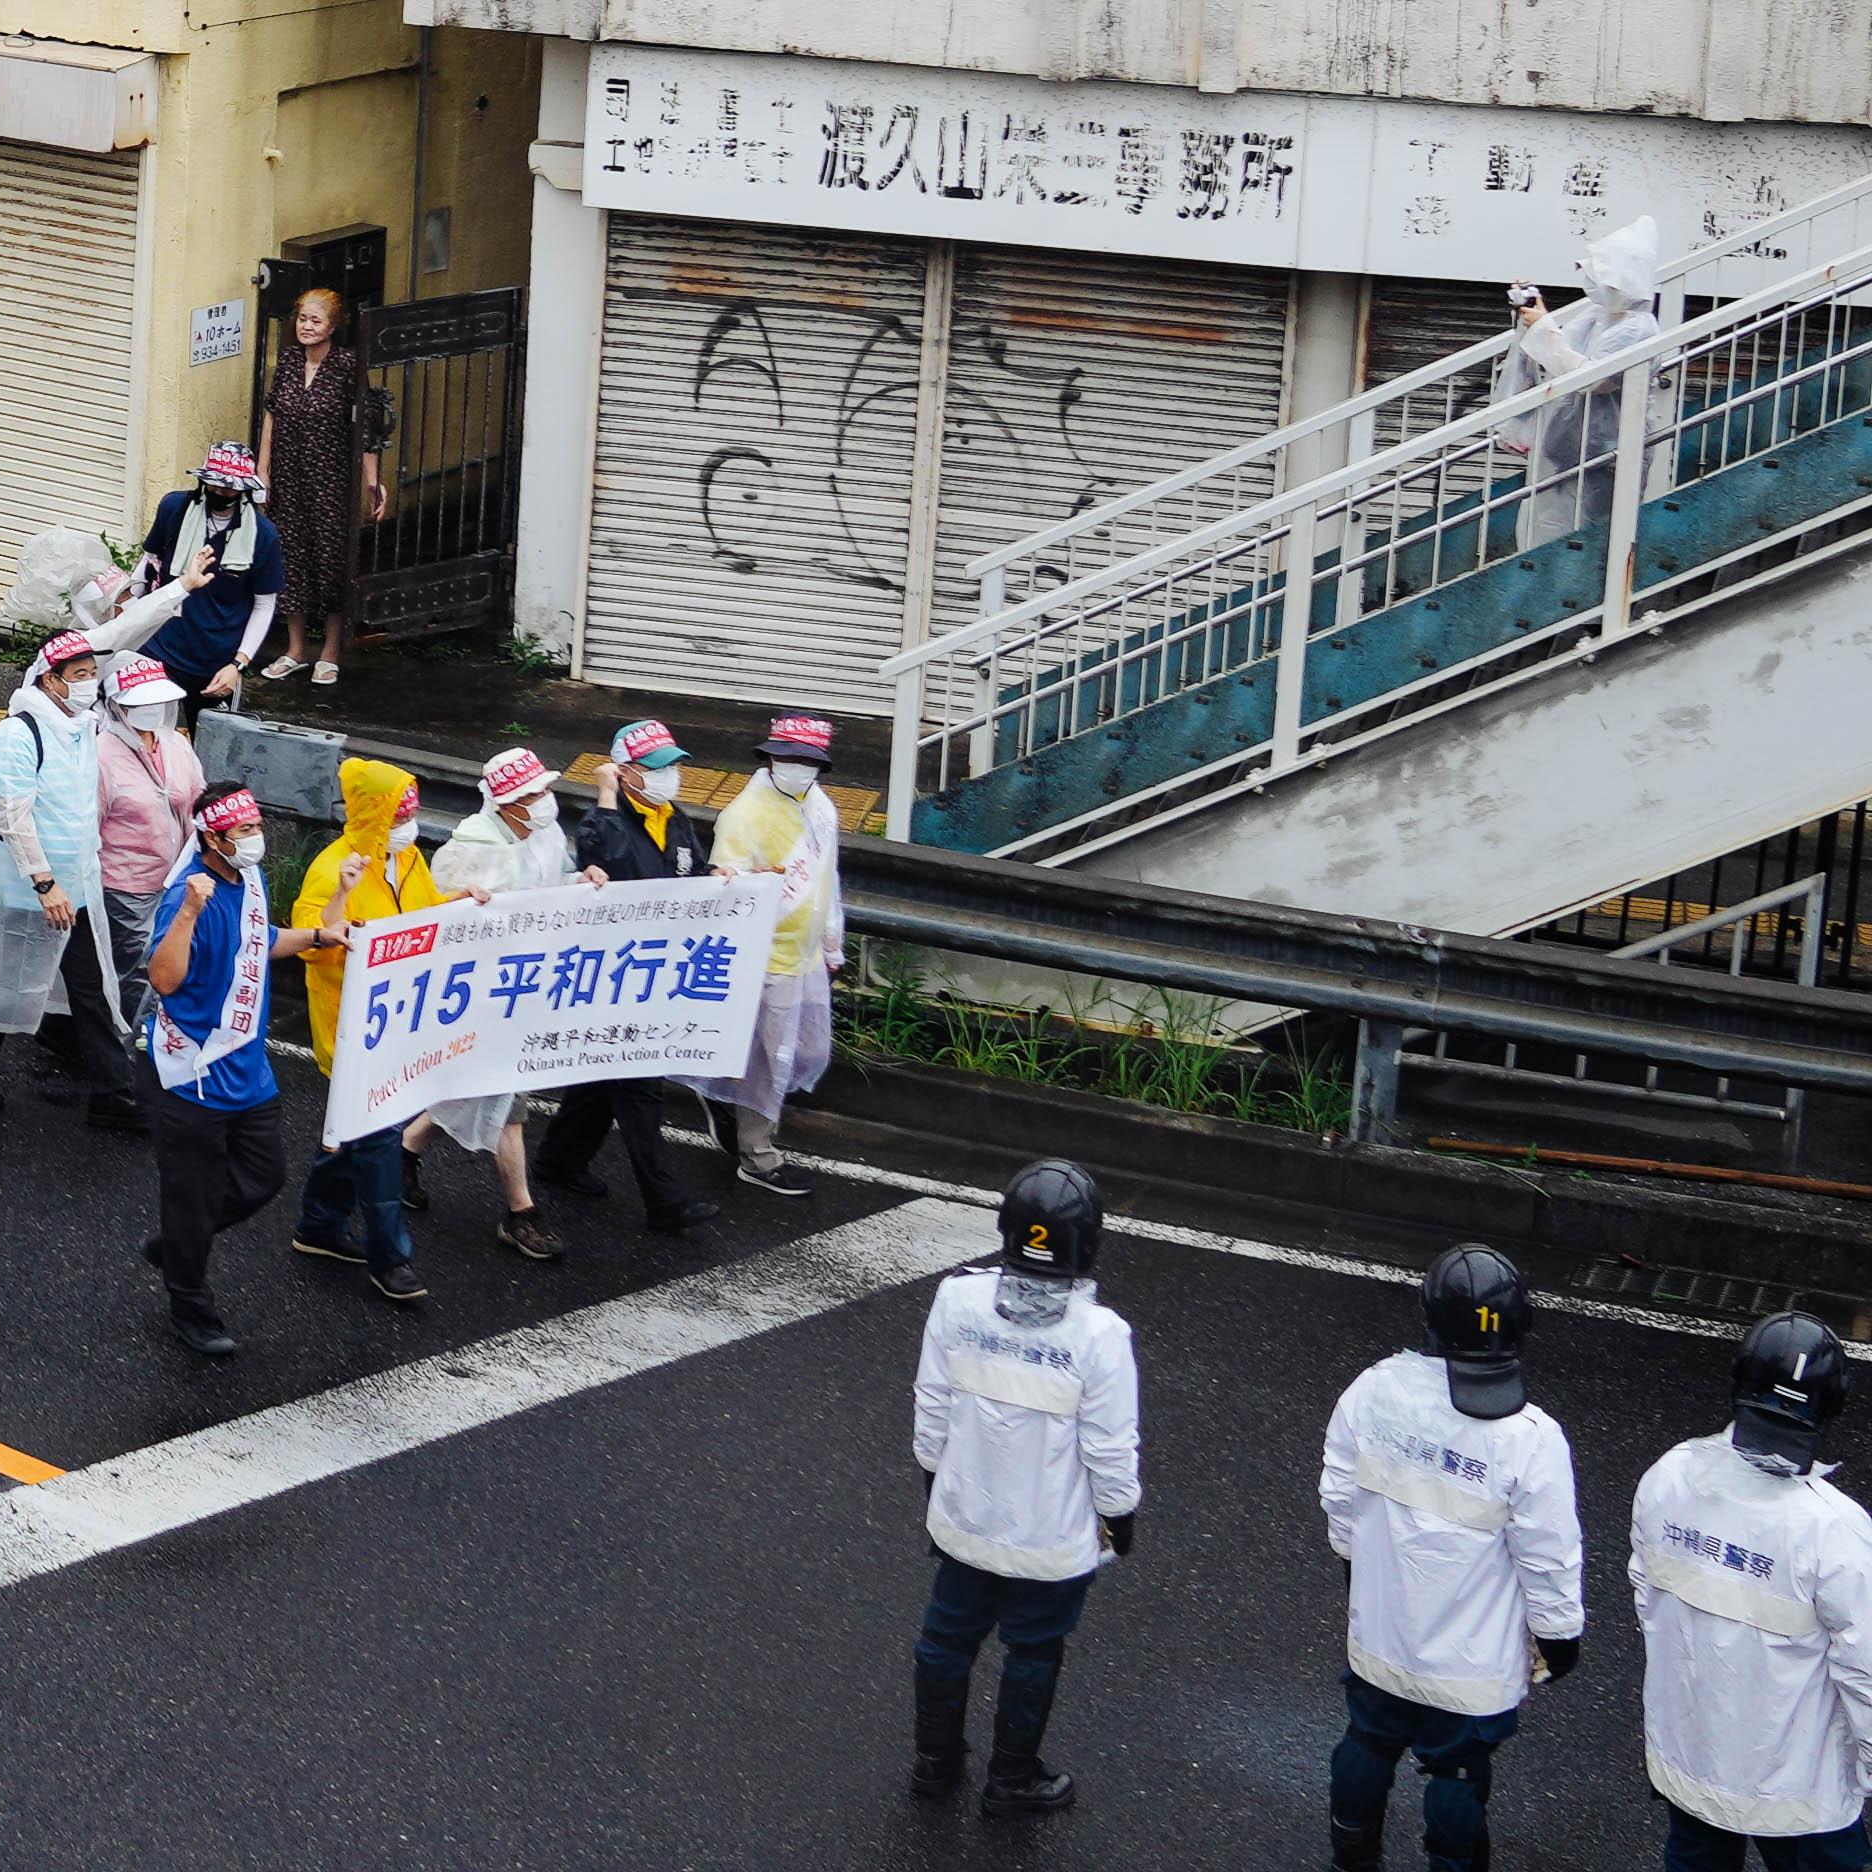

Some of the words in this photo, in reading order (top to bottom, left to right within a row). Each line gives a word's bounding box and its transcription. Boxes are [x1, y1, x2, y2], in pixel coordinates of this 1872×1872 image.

[489, 933, 739, 1019] 平和行進
[517, 1055, 574, 1074] Okinawa
[577, 1051, 616, 1069] Peace
[619, 1047, 659, 1064] Action
[664, 1045, 718, 1062] Center
[367, 1073, 400, 1114] Peace
[400, 1047, 445, 1085] Action
[1028, 1224, 1049, 1251] 2
[1474, 1305, 1501, 1335] 11
